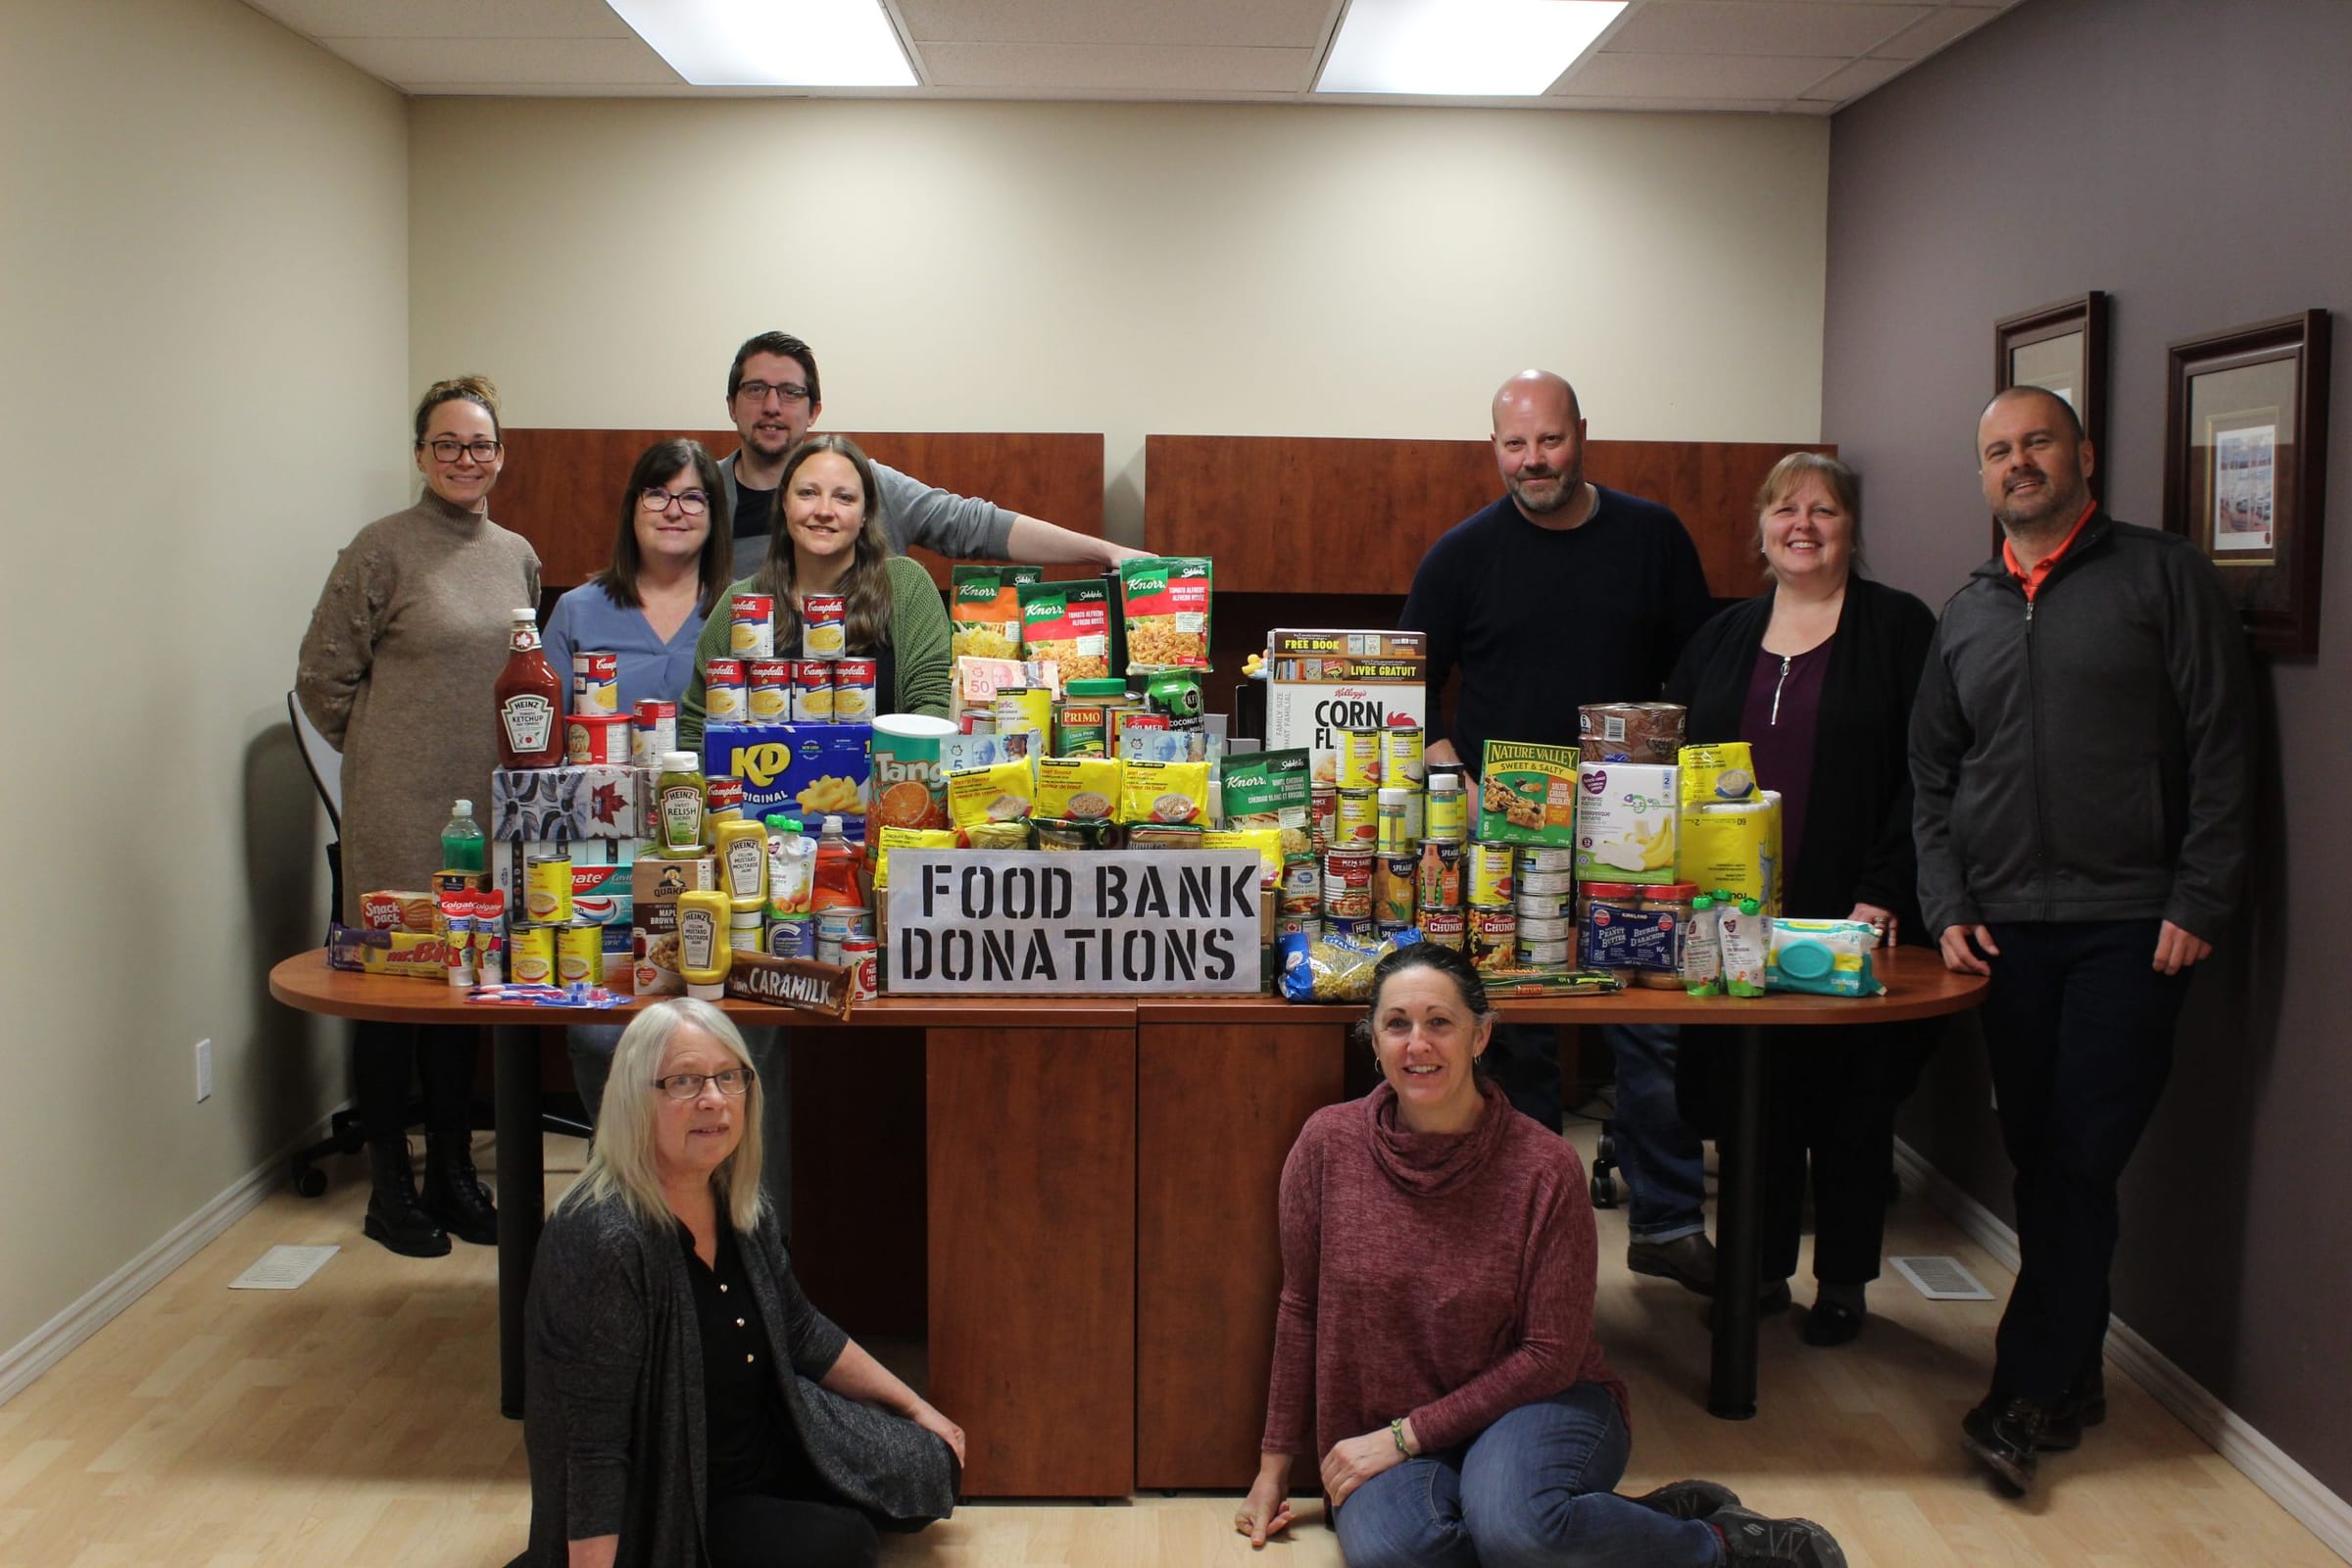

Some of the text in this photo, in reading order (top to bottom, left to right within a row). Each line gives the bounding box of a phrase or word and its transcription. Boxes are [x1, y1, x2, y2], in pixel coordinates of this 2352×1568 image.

[958, 584, 997, 597] Knorr
[1127, 578, 1166, 591] Knorr
[1025, 604, 1065, 616] Knorr
[1285, 640, 1339, 650] FREE BOOK
[1350, 666, 1417, 676] LIVRE GRATUIT
[971, 681, 990, 693] 50
[1335, 687, 1367, 699] Kellogg's
[514, 701, 539, 710] HEINZ
[1063, 711, 1100, 722] PRIMO
[1315, 700, 1383, 727] CORN
[1170, 717, 1198, 727] COCONUT
[1582, 715, 1587, 726] 6
[1490, 745, 1577, 767] NATURE VALLEY
[731, 742, 791, 788] KD
[1539, 765, 1564, 775] SALTY
[1225, 776, 1266, 789] Knorr
[743, 790, 788, 804] RIGINAL
[1484, 821, 1490, 831] 6
[922, 864, 1256, 919] FOOD BANK
[366, 902, 401, 916] Snack
[373, 913, 401, 927] pack
[685, 912, 708, 921] HEINZ
[1356, 923, 1372, 933] HEIN
[1430, 923, 1463, 932] CHUNKY
[1598, 928, 1625, 939] PEANUT
[1634, 925, 1658, 937] BEURRE
[1602, 935, 1627, 948] BUTTER
[902, 927, 1236, 982] DONATIONS
[749, 967, 830, 1004] CARAMILK
